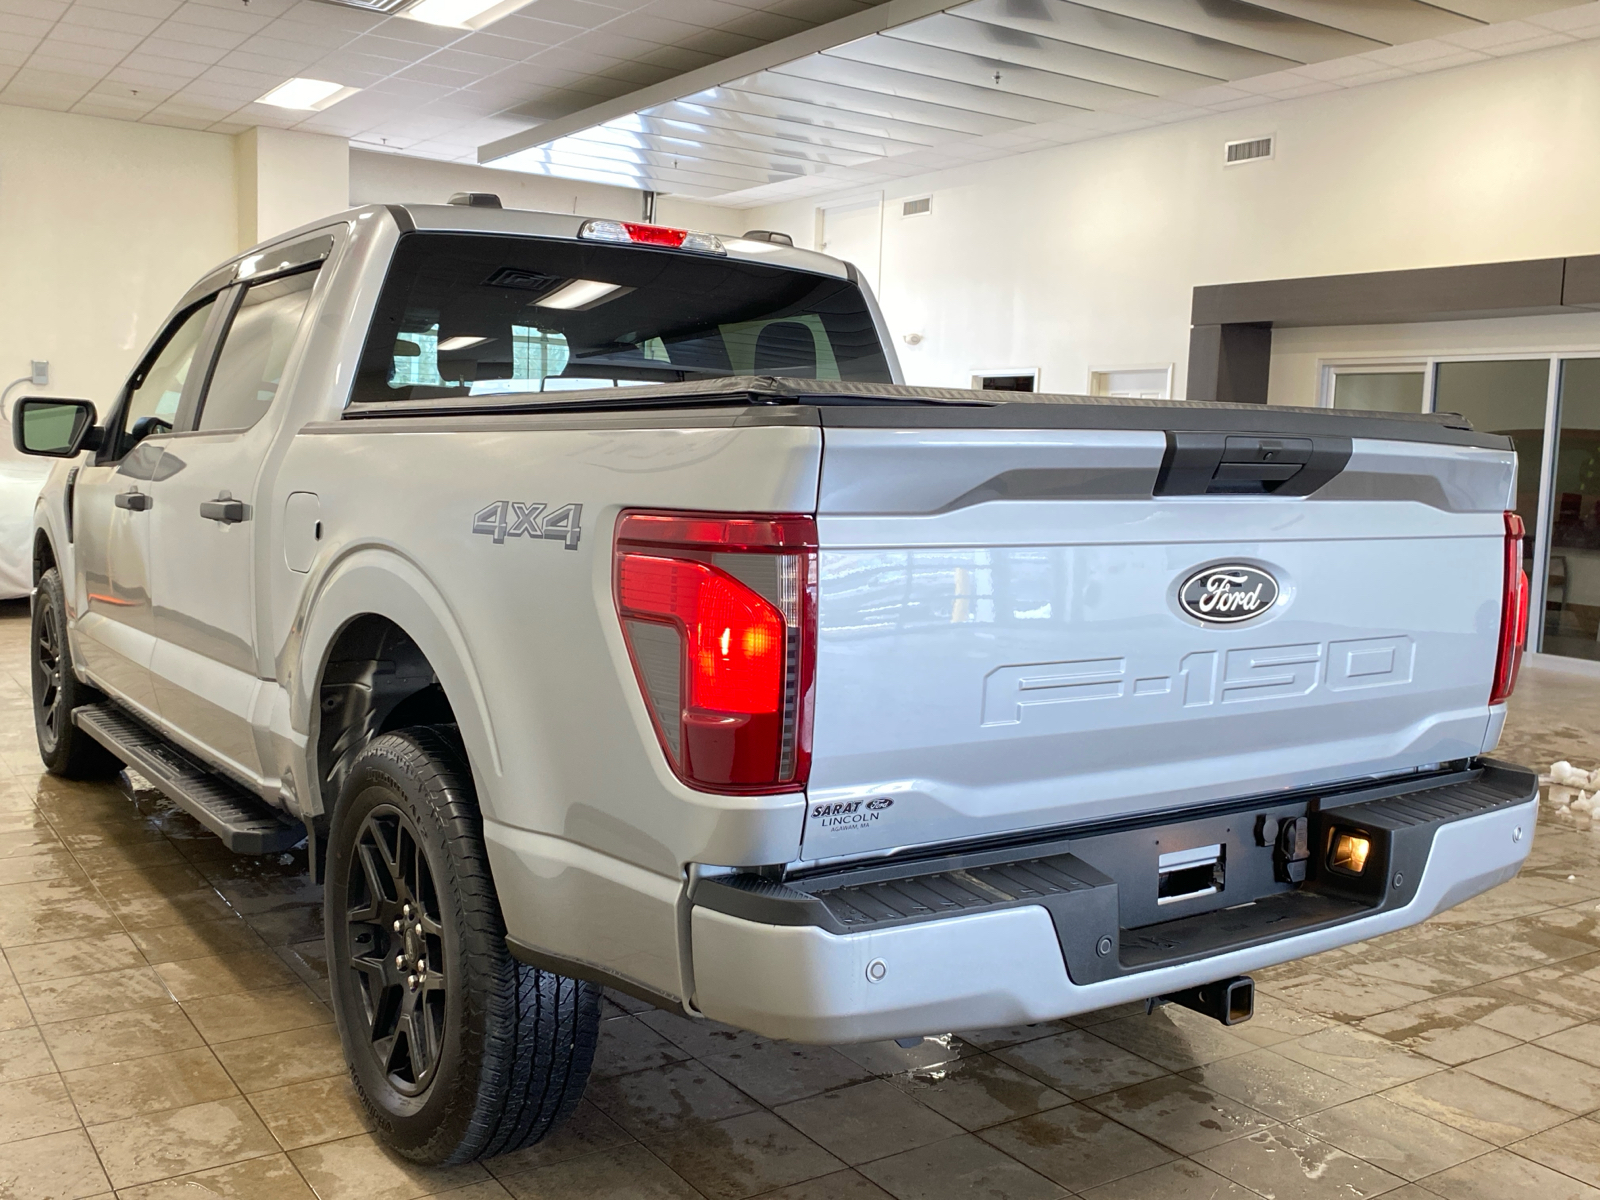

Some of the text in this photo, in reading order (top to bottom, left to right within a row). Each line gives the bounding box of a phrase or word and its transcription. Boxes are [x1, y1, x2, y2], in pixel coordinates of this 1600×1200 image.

[1198, 573, 1263, 612] Ford
[980, 635, 1416, 727] F-150
[811, 800, 890, 817] SARAT Ford
[821, 812, 880, 827] LINCOLN
